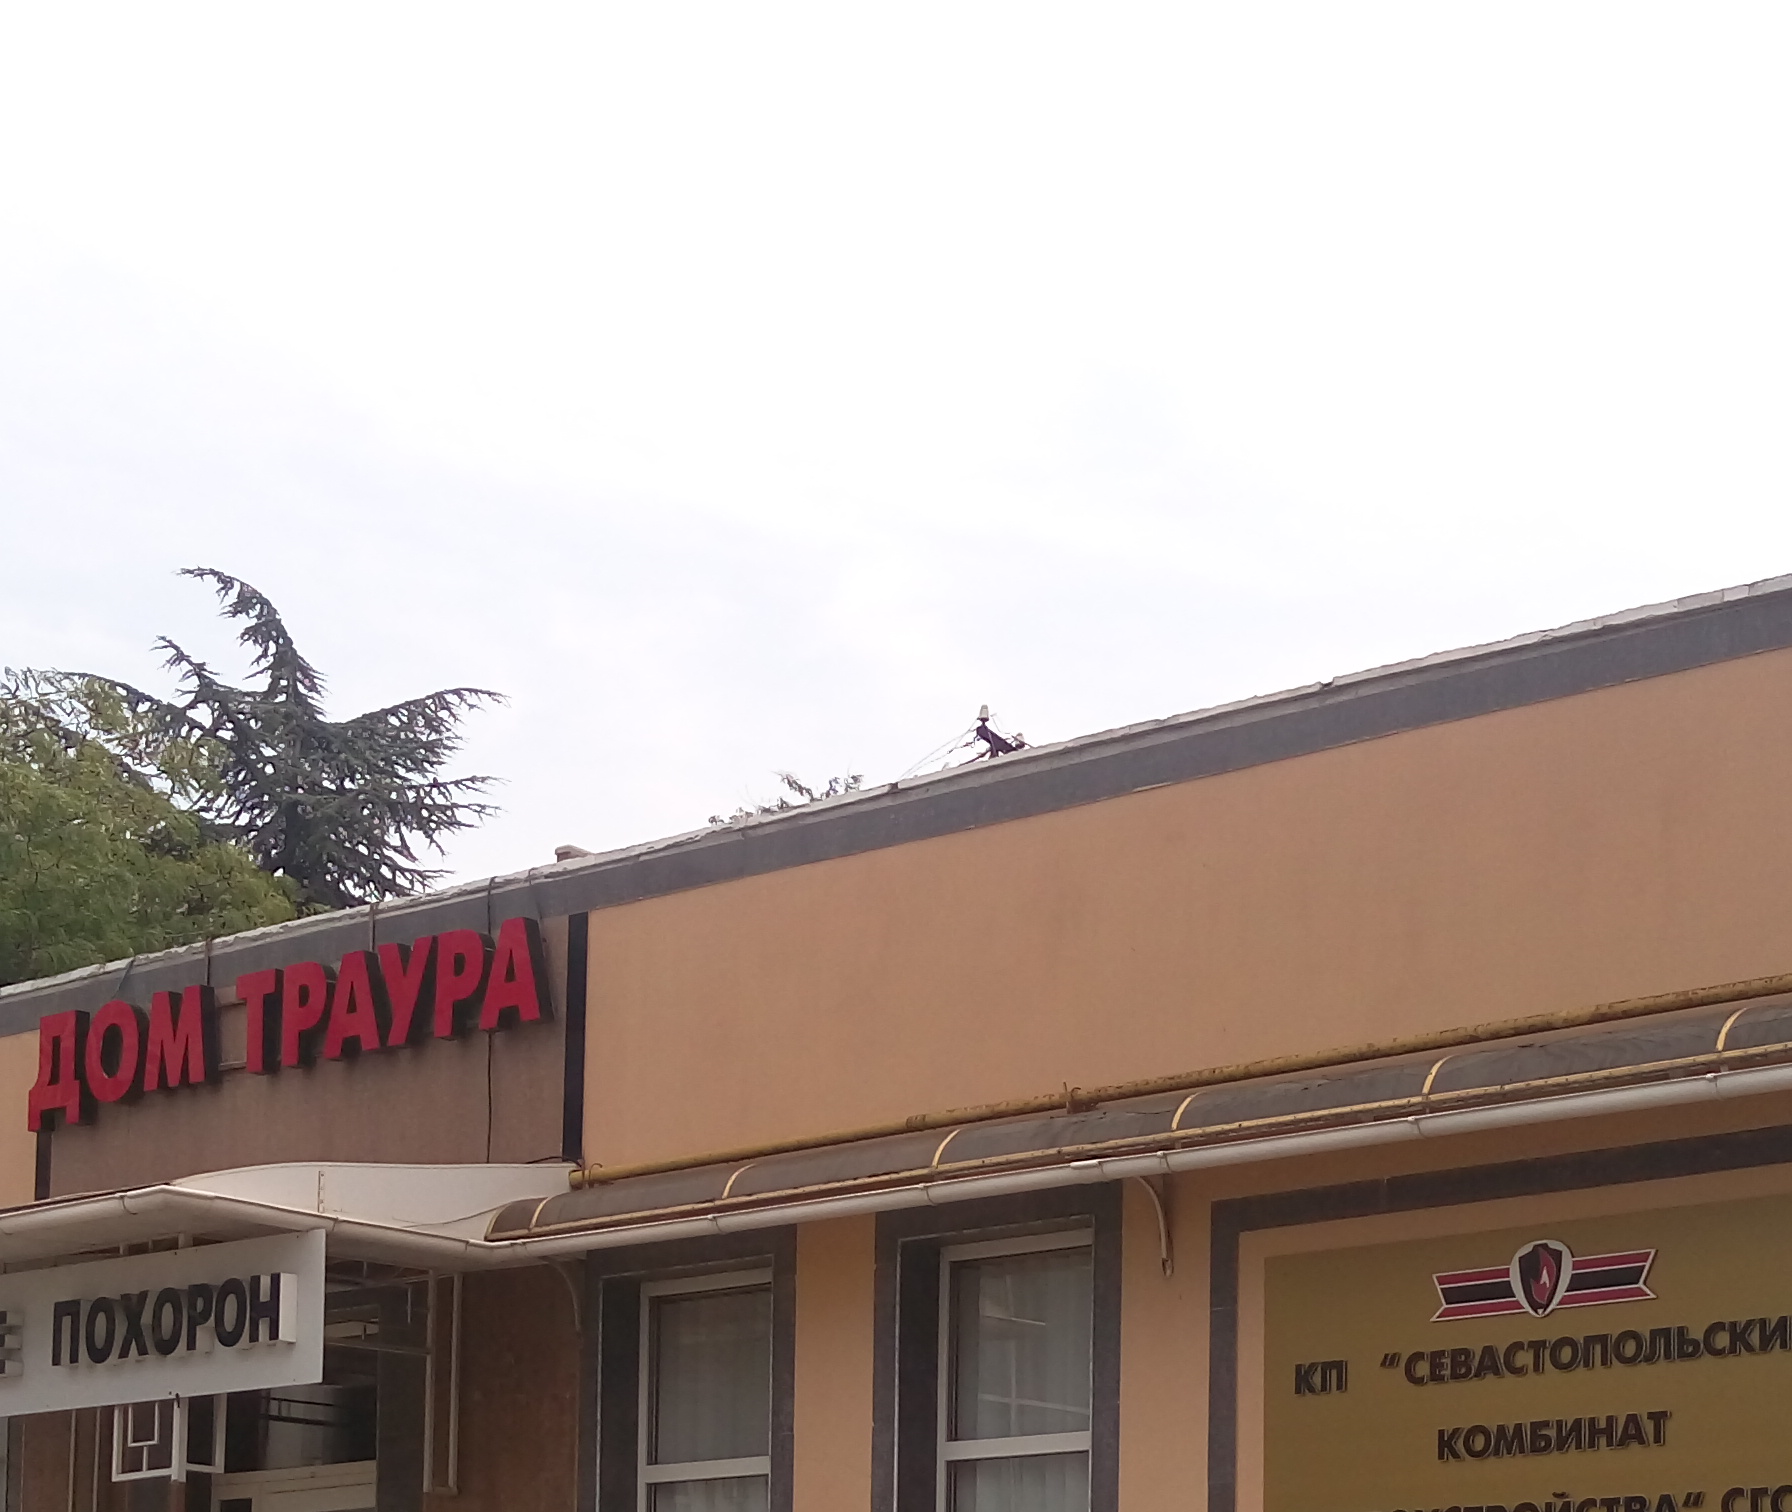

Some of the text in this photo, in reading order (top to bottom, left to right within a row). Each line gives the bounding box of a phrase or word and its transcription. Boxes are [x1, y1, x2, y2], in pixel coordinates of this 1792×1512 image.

[28, 917, 542, 1132] ДОМ ТРАУРА
[51, 1272, 283, 1367] ПОХОРОН
[1293, 1359, 1348, 1395] КП
[1436, 1409, 1672, 1461] КОМБИНАТ
